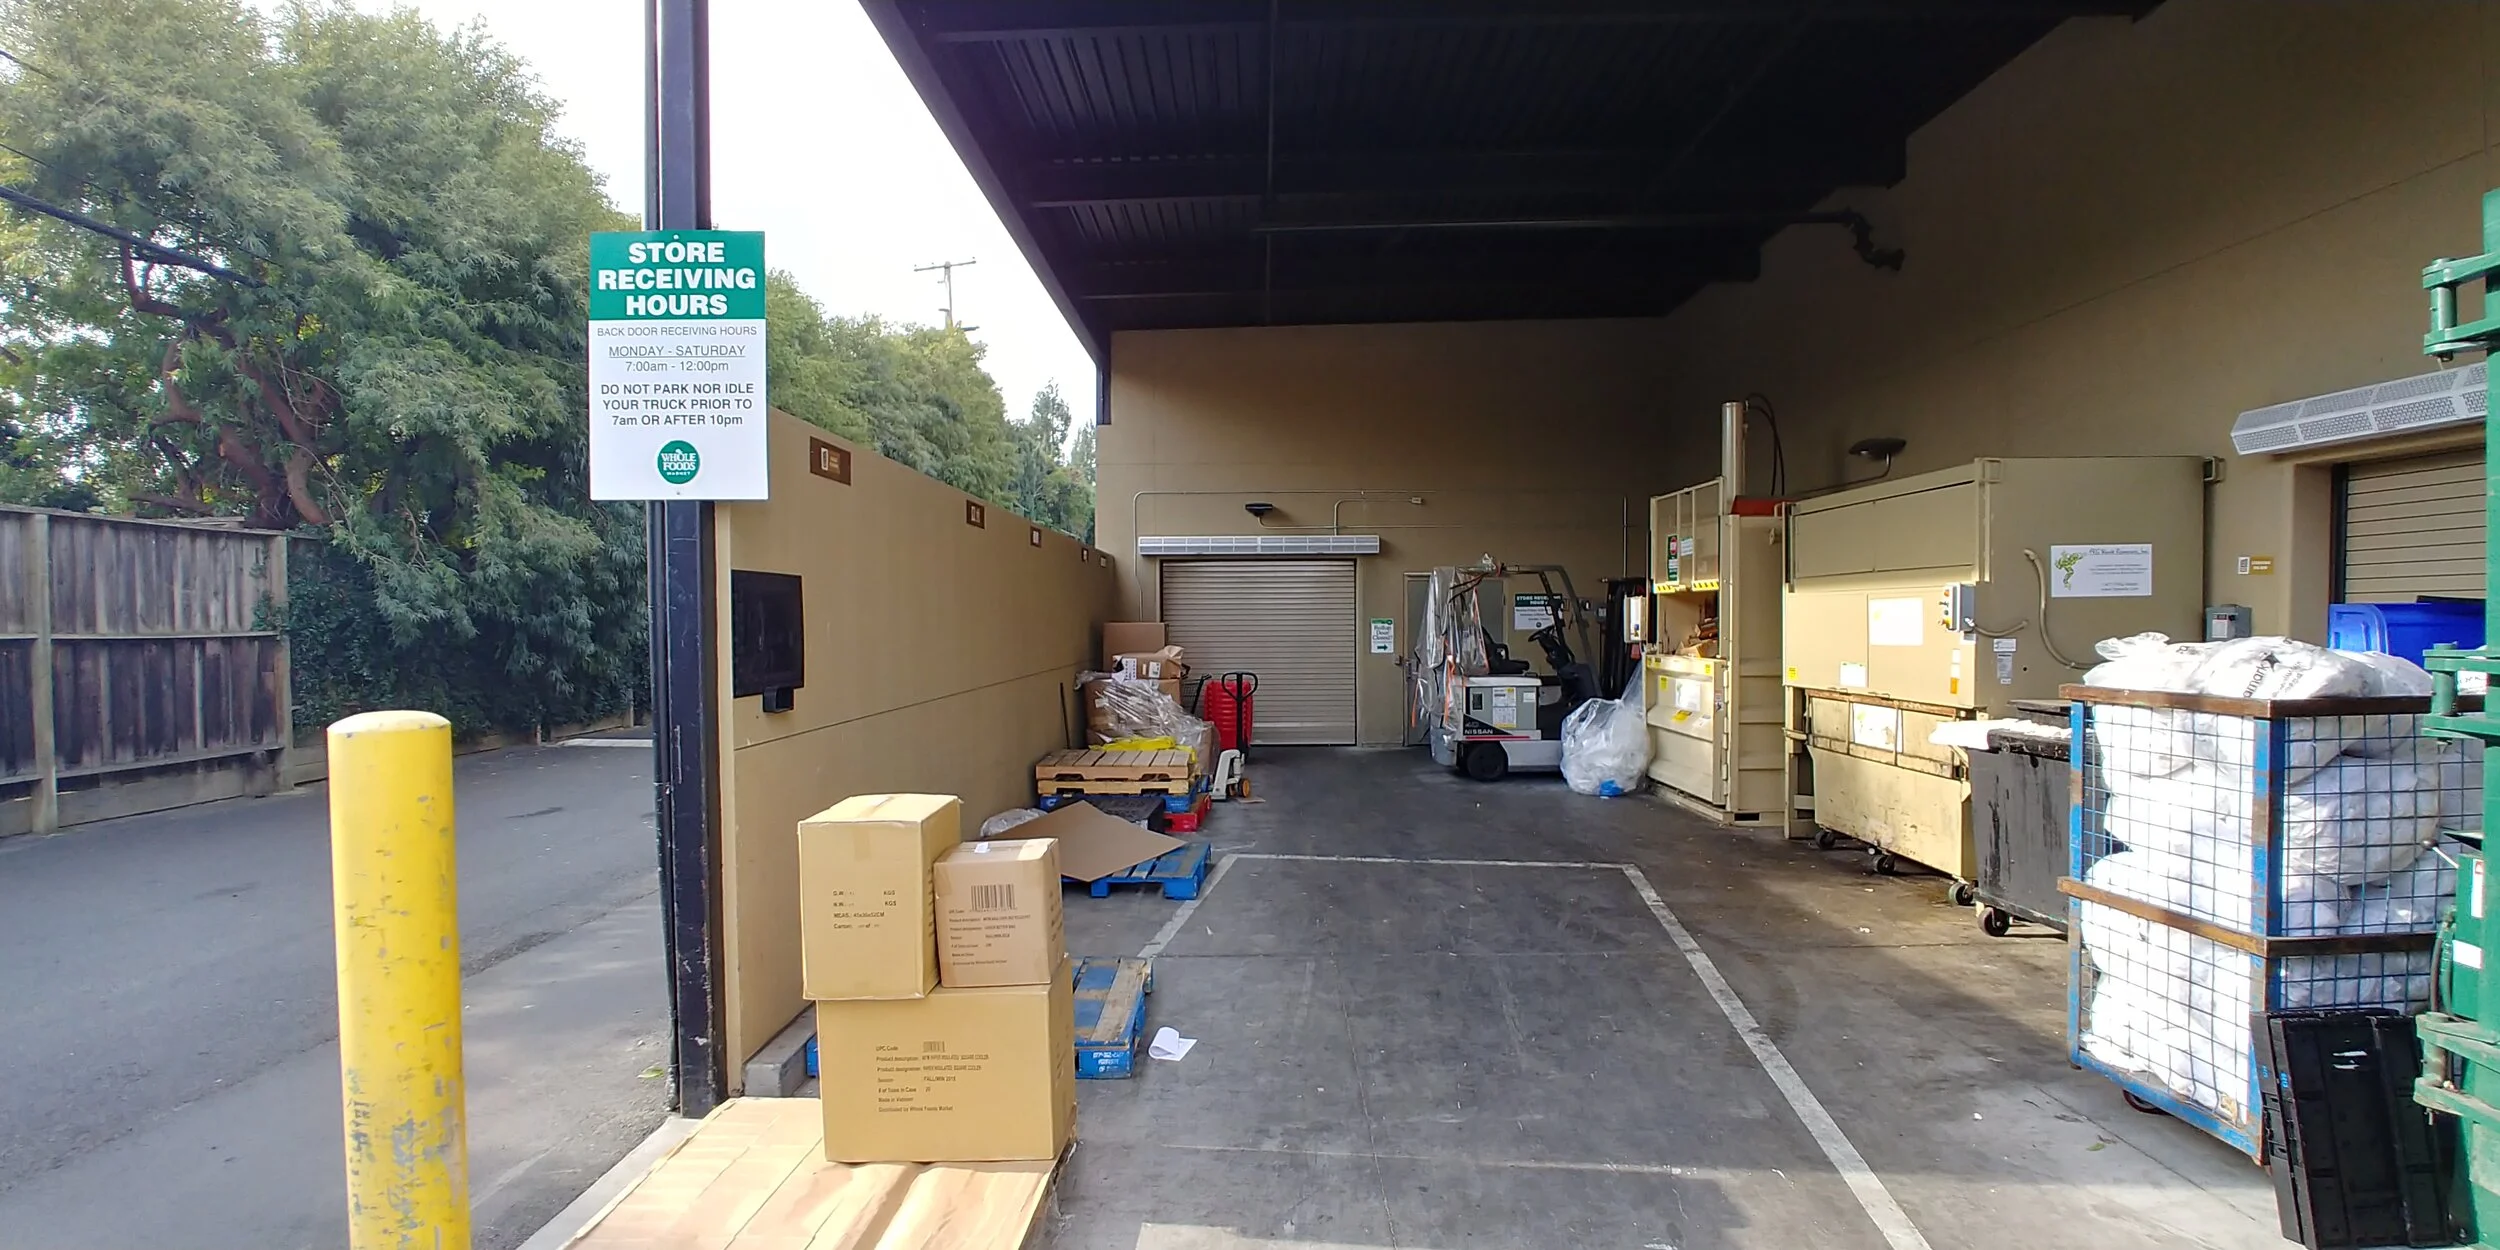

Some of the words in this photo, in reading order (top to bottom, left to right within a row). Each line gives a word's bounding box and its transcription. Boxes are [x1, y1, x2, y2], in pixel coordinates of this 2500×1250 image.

[628, 242, 724, 264] STORE
[598, 268, 756, 290] RECEIVING
[626, 294, 728, 316] HOURS
[598, 328, 624, 336] BACK
[628, 327, 658, 336] DOOR
[660, 326, 716, 336] RECEIVING
[720, 326, 757, 336] HOURS
[608, 346, 664, 357] MONDAY
[676, 345, 746, 356] SATURDAY
[626, 361, 668, 371] 7:00am
[680, 361, 729, 373] 12:00pm
[601, 384, 620, 394] DO
[624, 384, 650, 394] NOT
[654, 384, 689, 394] PARK
[693, 384, 721, 394] NOR
[725, 383, 754, 393] IDLE
[603, 400, 639, 410] YOUR
[643, 399, 687, 410] TRUCK
[691, 399, 732, 409] PRIOR
[734, 399, 752, 409] TO
[612, 415, 637, 425] 7am
[641, 415, 660, 425] OR
[664, 415, 706, 425] AFTER
[710, 414, 743, 426] 10pm
[661, 452, 696, 461] WHOLE
[663, 462, 696, 471] FOODS
